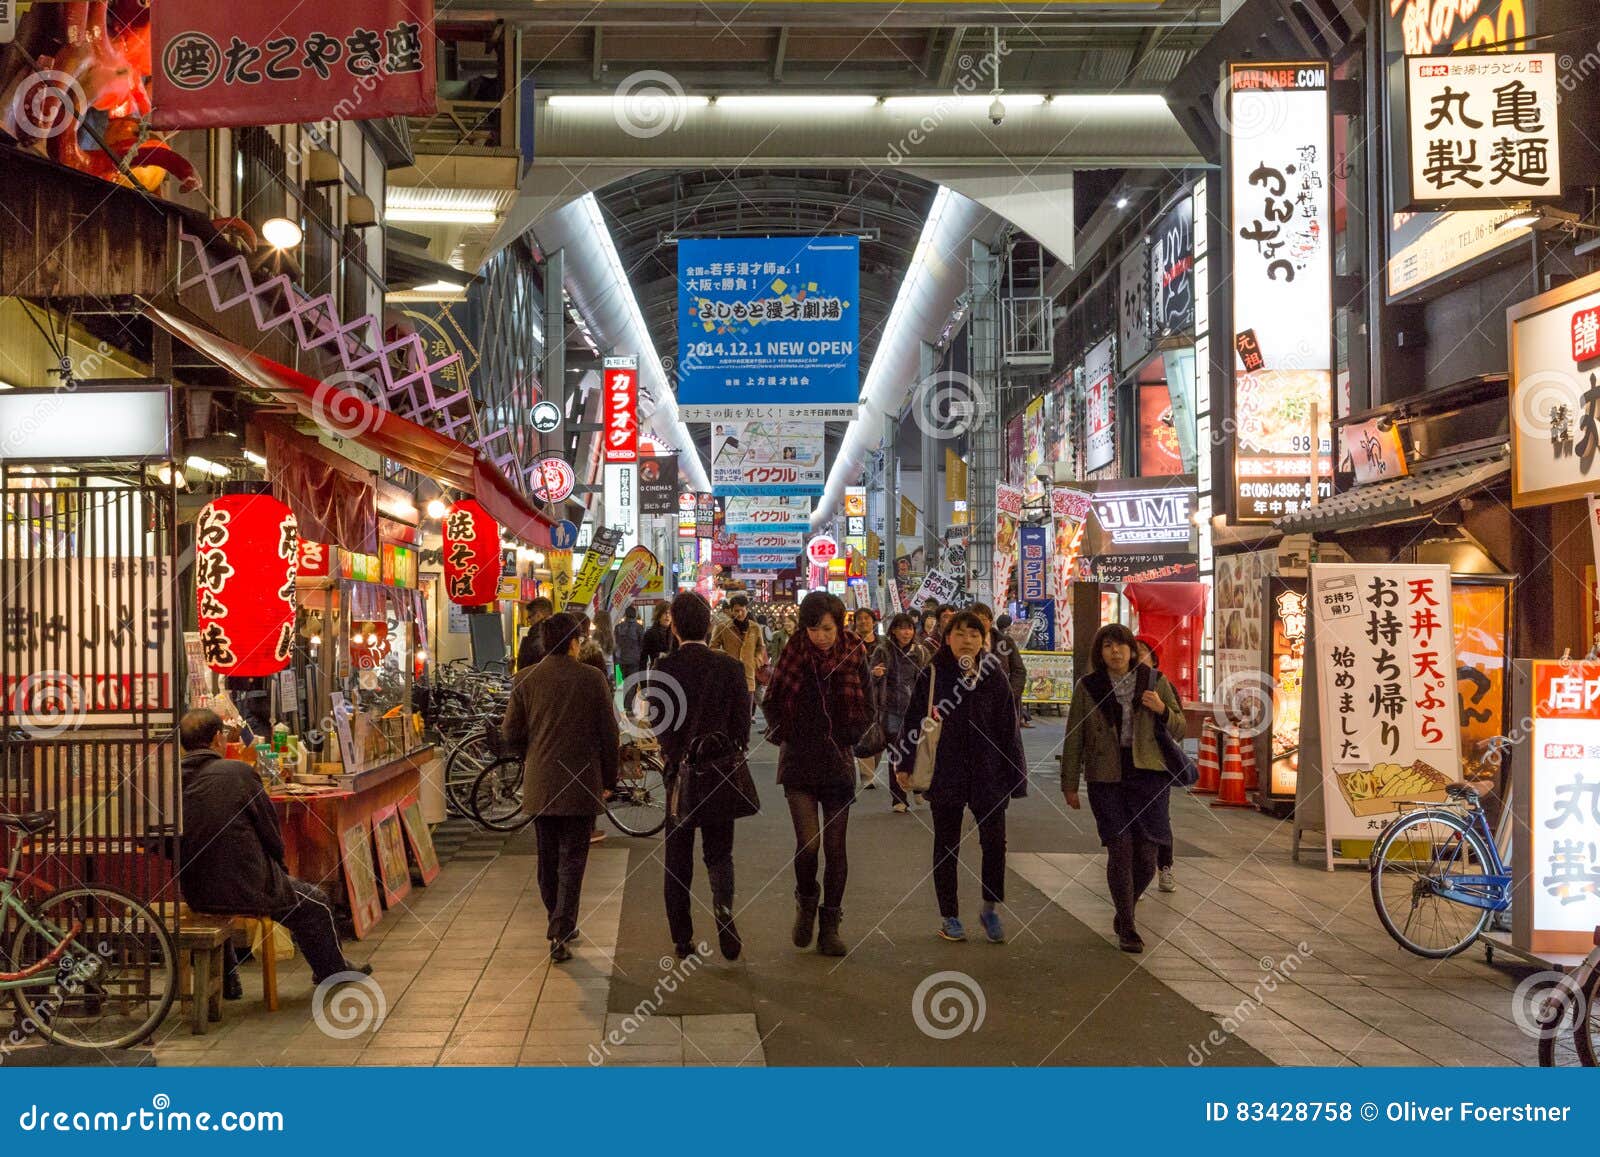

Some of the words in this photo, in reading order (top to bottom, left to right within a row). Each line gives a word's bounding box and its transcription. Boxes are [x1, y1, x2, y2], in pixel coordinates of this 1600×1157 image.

[224, 21, 424, 84] たこやき座
[1234, 69, 1325, 89] KAN-NABE.COM
[700, 300, 842, 320] よしもと漫才劇場
[687, 342, 762, 356] 2014.12.1
[767, 342, 804, 356] NEW
[808, 341, 853, 355] OPEN
[1238, 335, 1262, 368] 元祖
[610, 373, 632, 446] カラオケ
[1292, 435, 1330, 452] 98円
[744, 467, 797, 482] イククル
[448, 511, 480, 597] 焼そば
[810, 543, 836, 556] 123
[197, 503, 237, 666] お好み焼
[1324, 591, 1354, 605] お持ち
[1331, 604, 1351, 616] 帰り
[1365, 576, 1406, 757] お持ち帰り
[1330, 646, 1362, 761] 始めました
